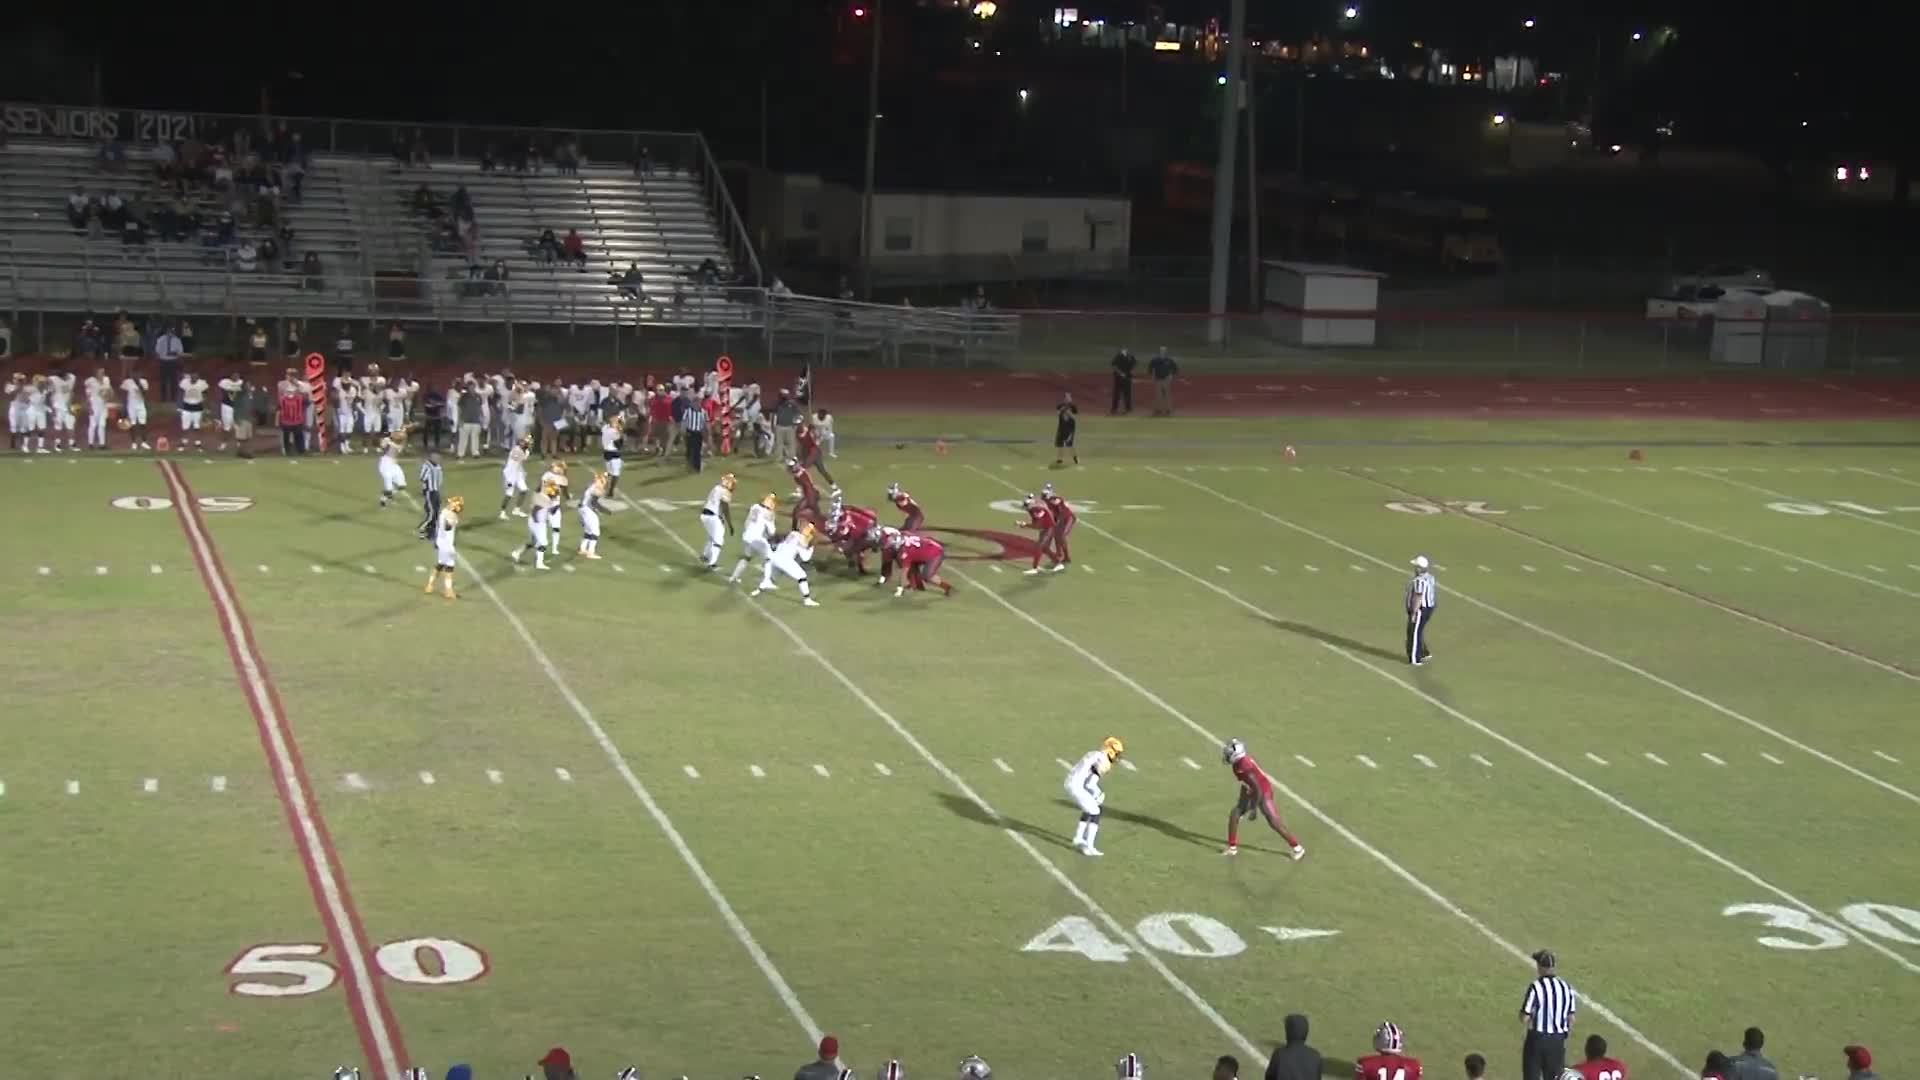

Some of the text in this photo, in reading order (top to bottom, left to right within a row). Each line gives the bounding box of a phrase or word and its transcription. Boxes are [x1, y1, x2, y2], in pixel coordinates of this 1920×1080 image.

[4, 107, 119, 138] SENIORS
[1020, 912, 1248, 962] 40
[1721, 902, 1920, 950] 30
[226, 937, 487, 997] 50
